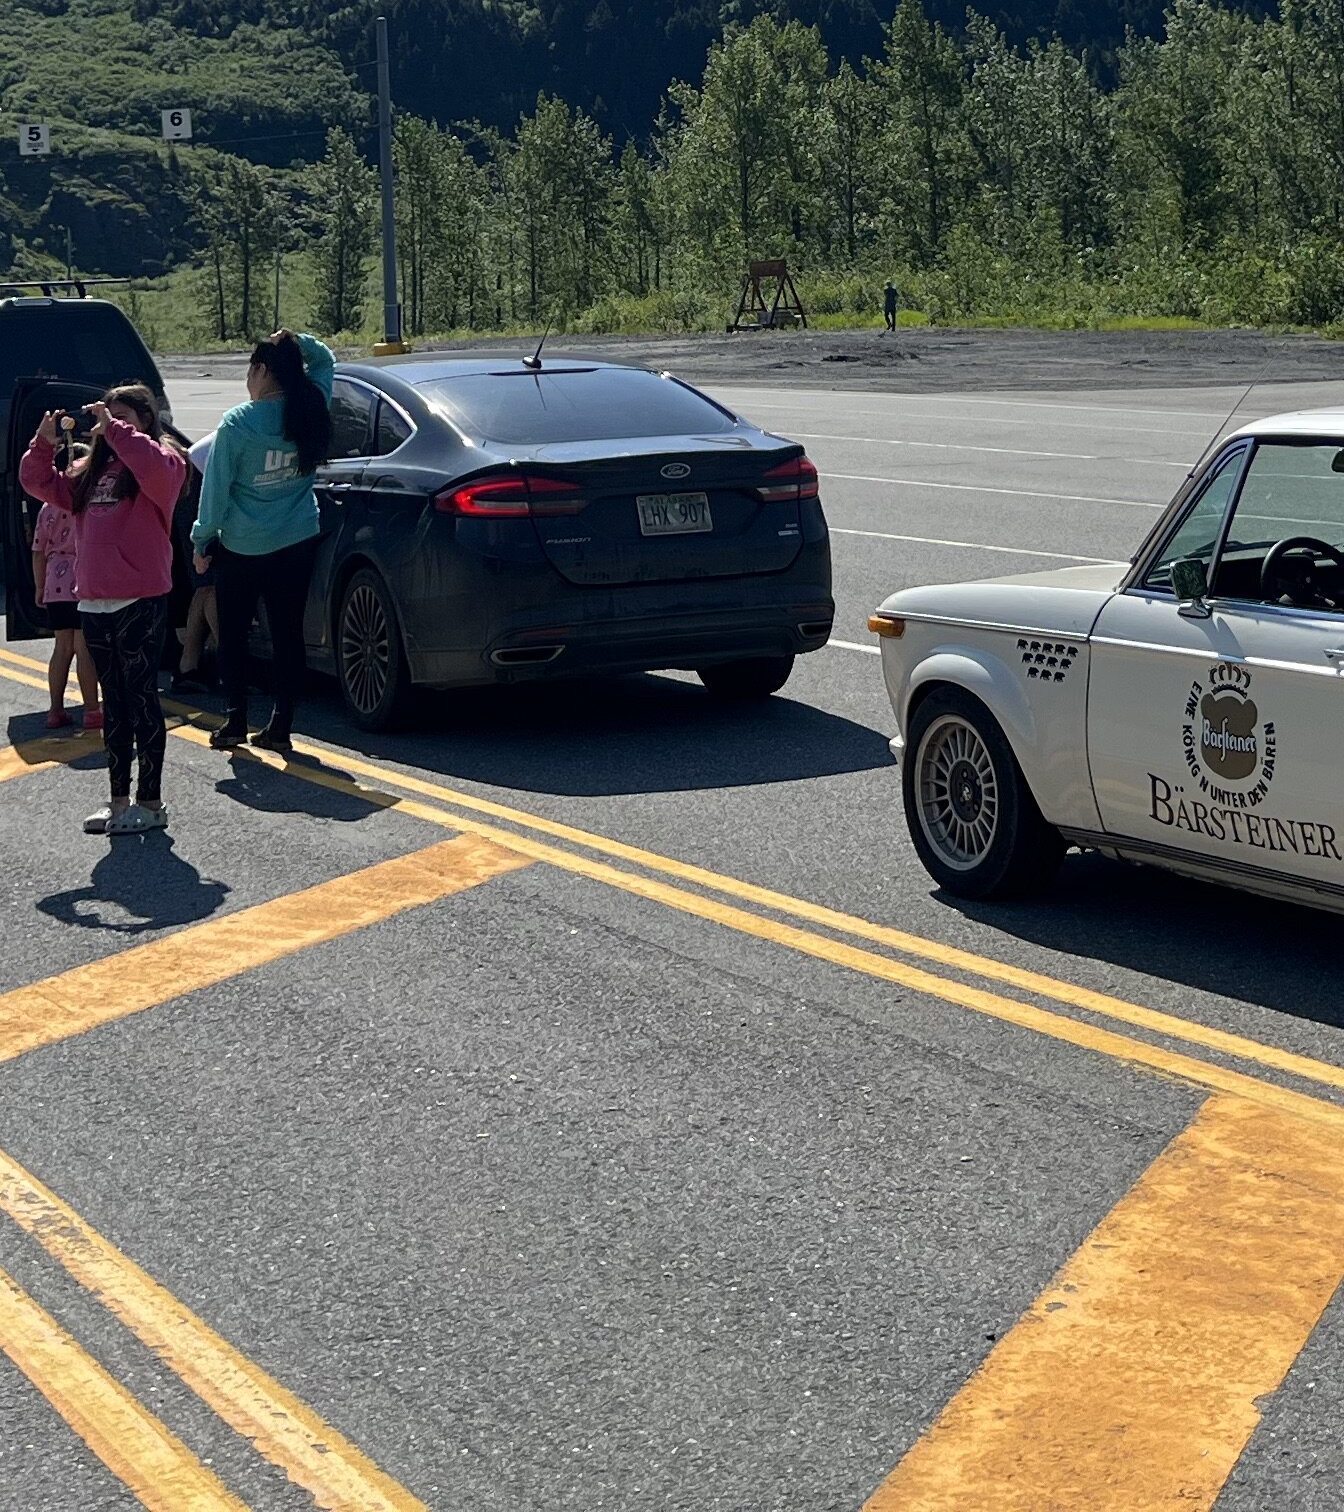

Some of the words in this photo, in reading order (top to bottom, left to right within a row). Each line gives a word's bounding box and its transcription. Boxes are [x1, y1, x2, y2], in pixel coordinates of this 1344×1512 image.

[169, 111, 183, 127] 6
[27, 126, 41, 142] 5
[641, 504, 671, 528] LHX
[679, 502, 706, 524] 907
[1184, 680, 1203, 721] EINE
[1210, 784, 1247, 809] UNTER
[1248, 779, 1269, 808] DEN
[1147, 771, 1343, 862] BÄRSTEINER
